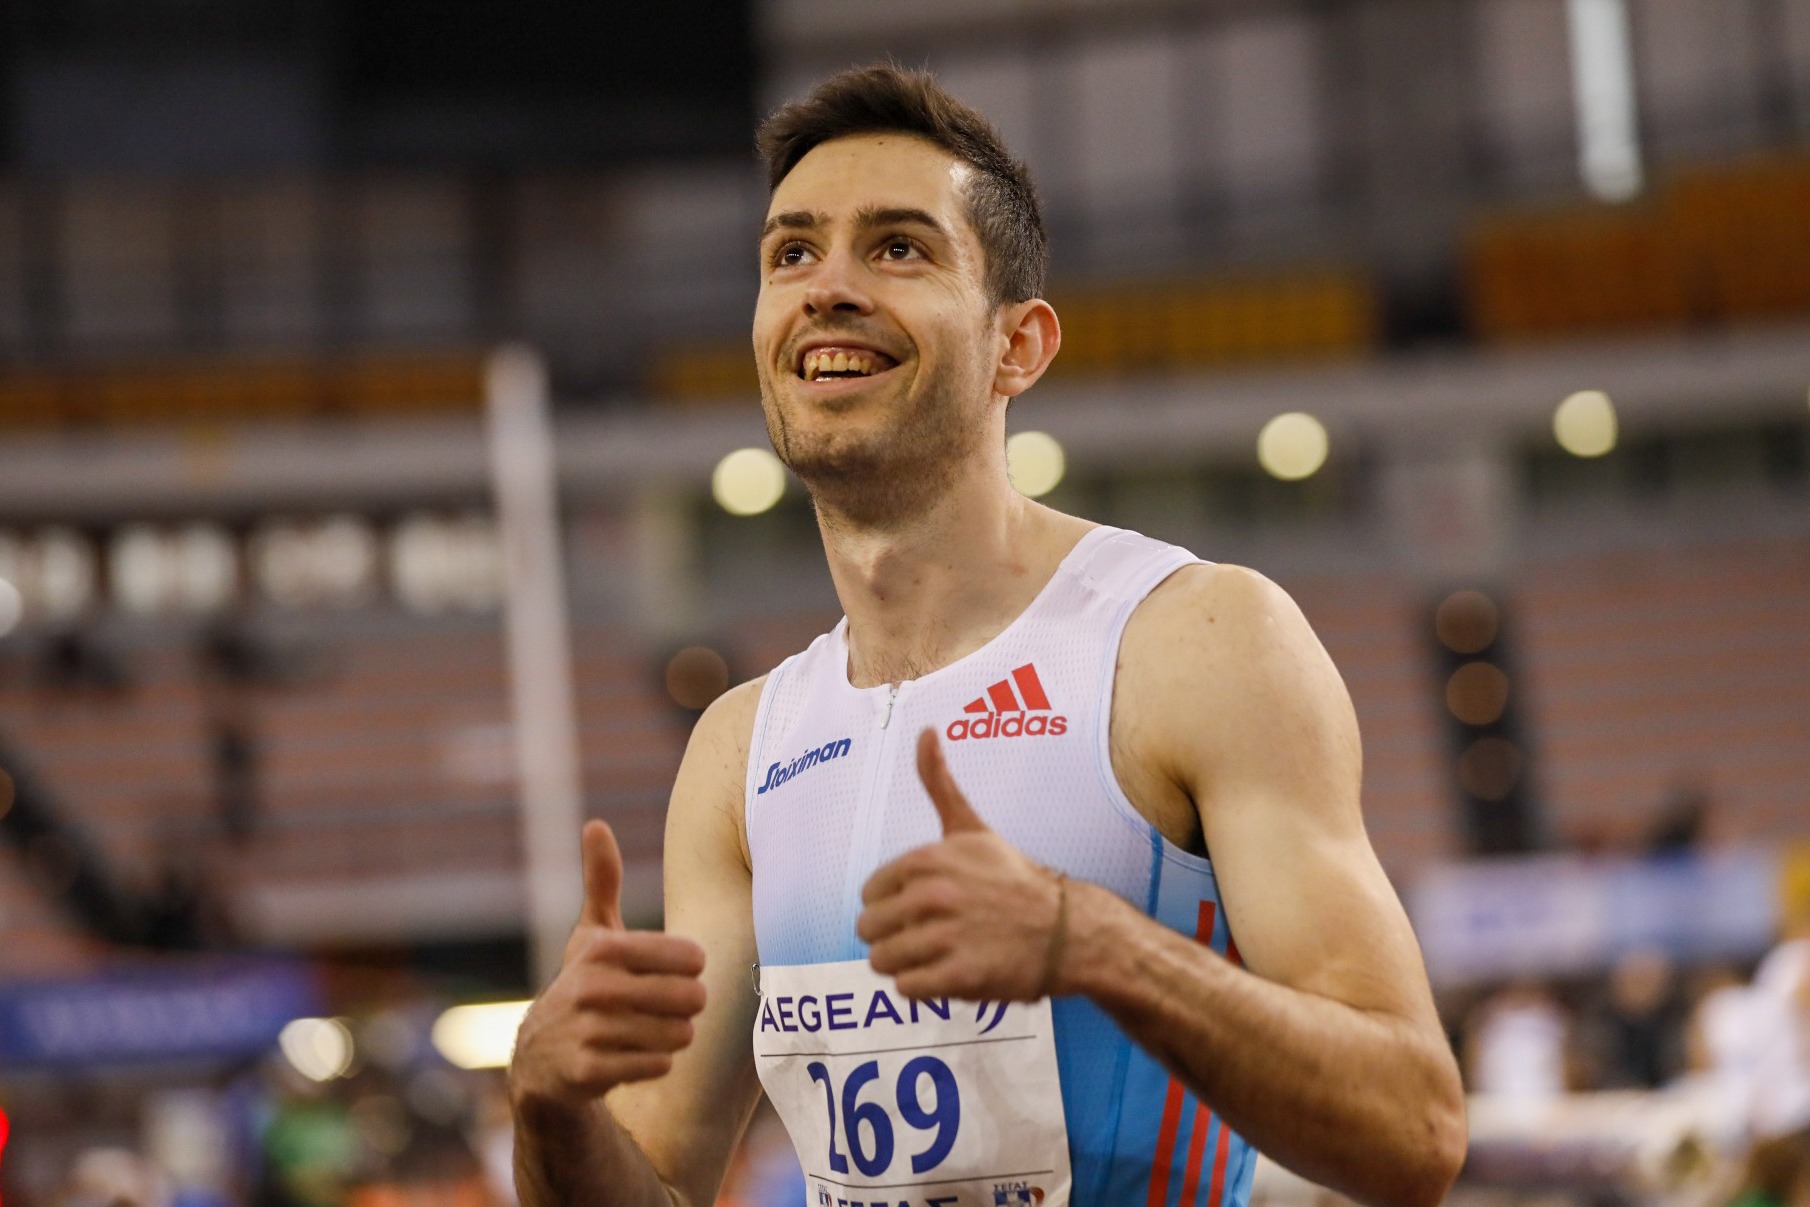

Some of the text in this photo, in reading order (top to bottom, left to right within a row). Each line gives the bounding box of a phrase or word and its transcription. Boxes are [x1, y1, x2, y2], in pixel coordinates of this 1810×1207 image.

[946, 711, 1068, 741] adidas
[757, 738, 851, 794] Stoiximan
[761, 990, 951, 1033] AEGEAN
[806, 1055, 960, 1178] 269
